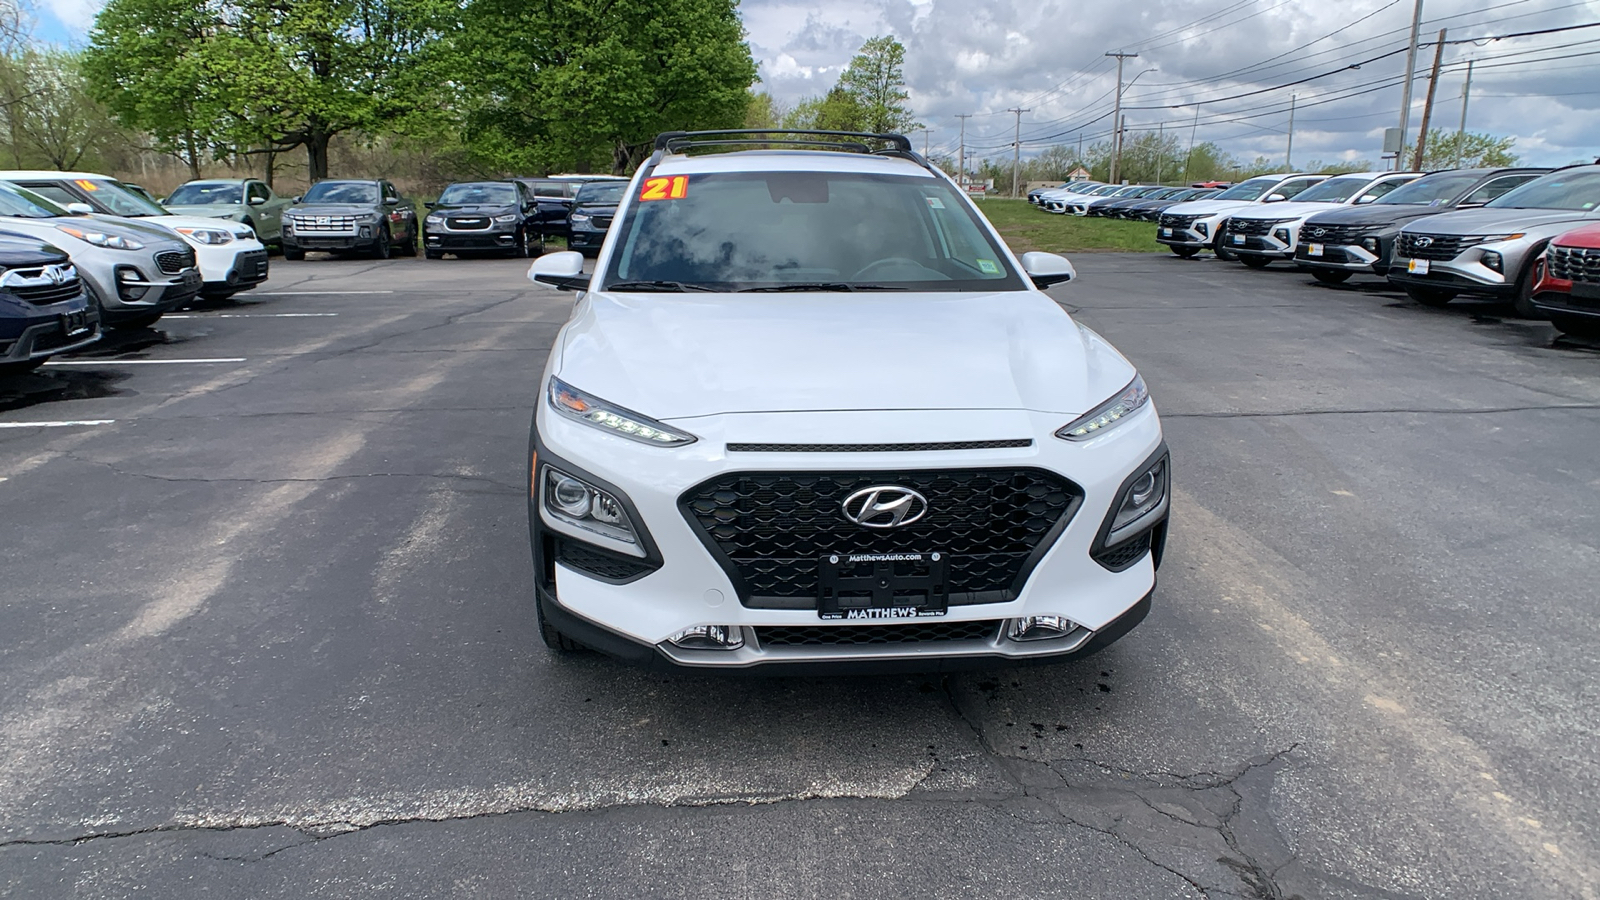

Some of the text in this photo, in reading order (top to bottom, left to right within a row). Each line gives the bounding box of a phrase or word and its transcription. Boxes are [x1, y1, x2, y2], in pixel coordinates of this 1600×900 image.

[641, 176, 687, 200] 21
[849, 554, 921, 562] MatthewsAuto.com
[847, 608, 917, 619] MATTHEWS
